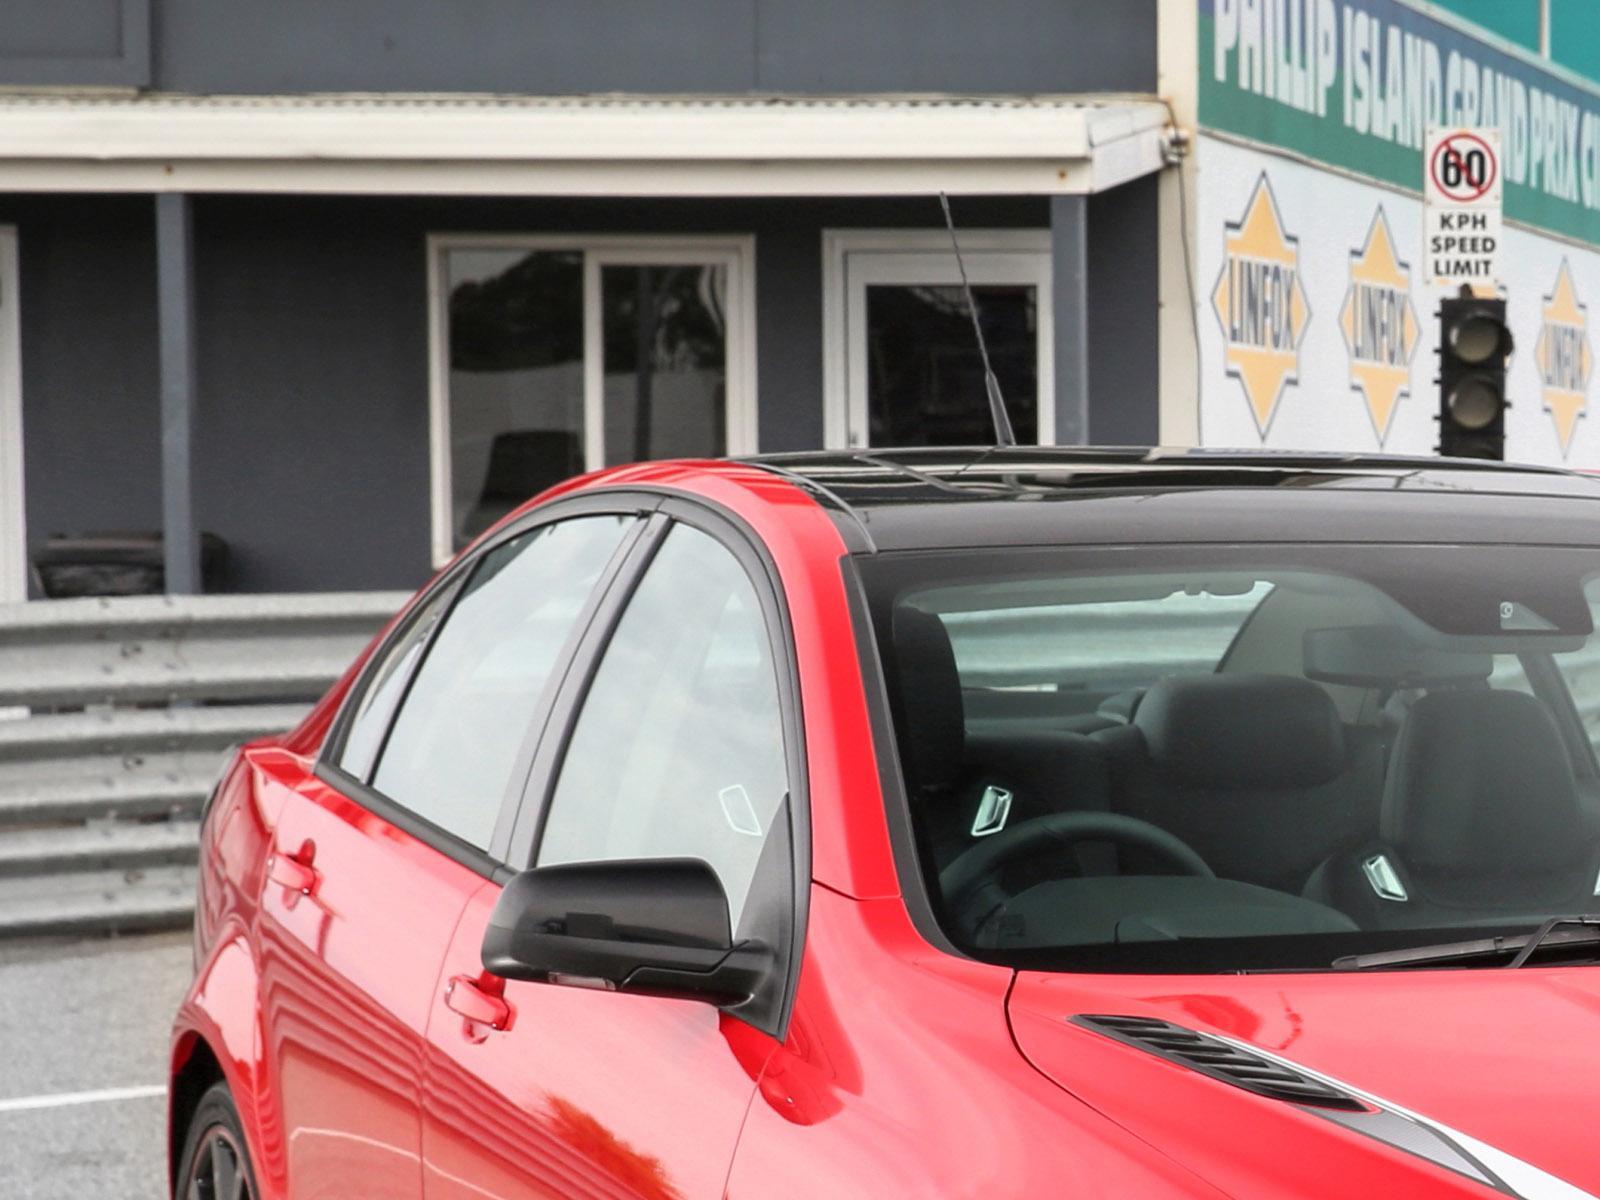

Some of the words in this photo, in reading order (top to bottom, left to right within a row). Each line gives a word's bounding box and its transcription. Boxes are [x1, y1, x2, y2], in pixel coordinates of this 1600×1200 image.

[1214, 0, 1338, 119] PHILLIP
[1342, 4, 1443, 152] ISLAND
[1530, 85, 1580, 205] PRIX
[1442, 149, 1486, 188] 60
[1440, 214, 1486, 229] KPH
[1431, 236, 1496, 253] SPEED
[1434, 260, 1491, 276] LIMIT
[1229, 257, 1297, 350] LINFOX
[1352, 281, 1411, 367] LINFOX
